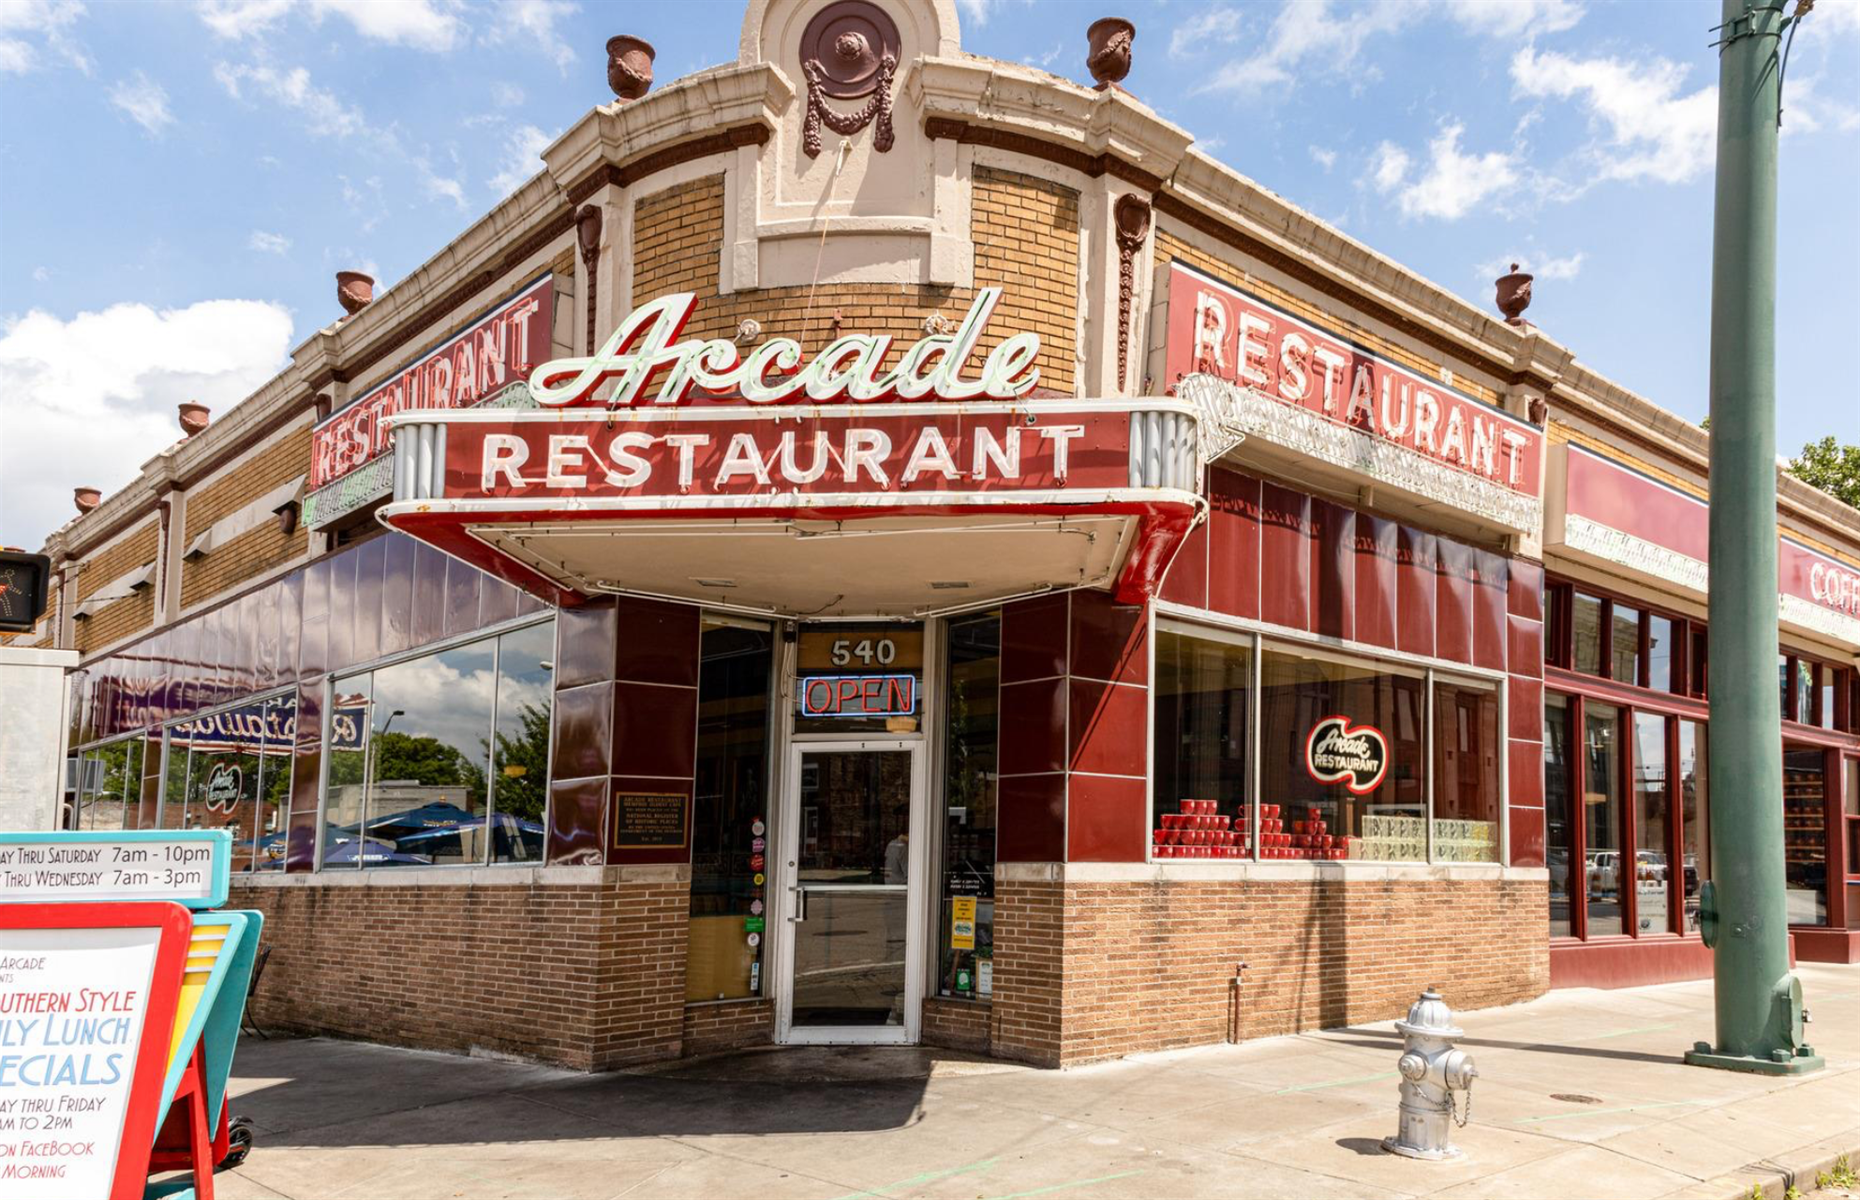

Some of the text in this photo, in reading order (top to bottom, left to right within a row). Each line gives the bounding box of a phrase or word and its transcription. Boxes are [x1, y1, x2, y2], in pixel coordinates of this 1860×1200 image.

[529, 288, 1041, 404] Arcade
[1194, 290, 1531, 485] RESTAURANT
[481, 424, 1086, 494] RESTAURANT
[831, 639, 896, 666] 540
[805, 678, 912, 713] OPEN
[1315, 727, 1371, 759] Arcade
[1314, 752, 1379, 773] RESTAURANT
[18, 848, 45, 864] THRU
[48, 847, 102, 864] SATURDAY
[112, 847, 147, 862] 7am
[164, 845, 210, 865] 10pm
[4, 871, 32, 887] THRU
[35, 870, 103, 887] WEDNESDAY
[113, 869, 148, 885] 7am
[163, 868, 201, 888] 3pm
[0, 957, 46, 970] ARCADE
[75, 988, 137, 1012] STYLE
[43, 1013, 131, 1046] LUNCH
[0, 1053, 123, 1087] ECIALS
[21, 1098, 54, 1113] THRU
[57, 1095, 106, 1113] FRIDAY
[20, 1117, 39, 1130] TO
[43, 1115, 73, 1130] 2PM
[1, 1164, 67, 1179] MORNING
